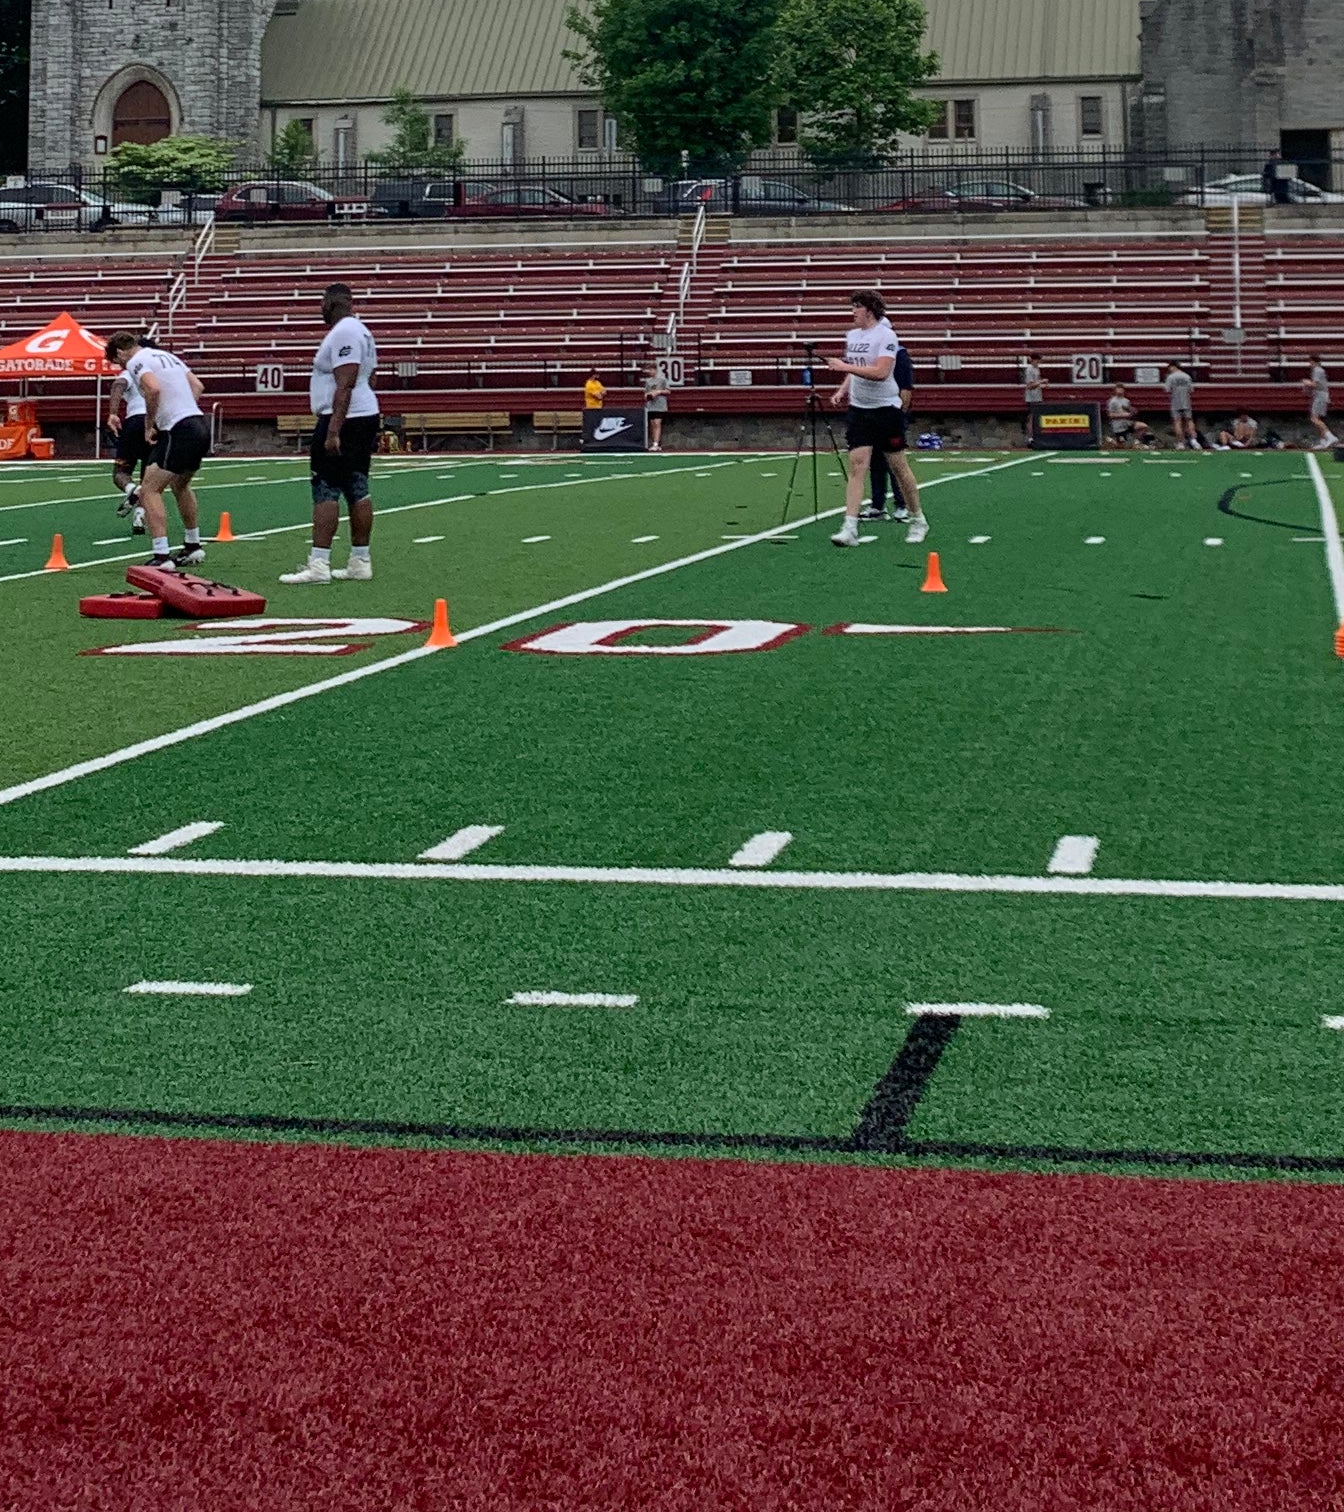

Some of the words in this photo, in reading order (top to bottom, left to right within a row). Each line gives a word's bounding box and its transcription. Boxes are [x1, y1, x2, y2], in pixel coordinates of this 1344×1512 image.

[25, 328, 71, 353] G
[258, 367, 281, 389] 40
[658, 360, 681, 382] 30
[1075, 357, 1100, 380] 20
